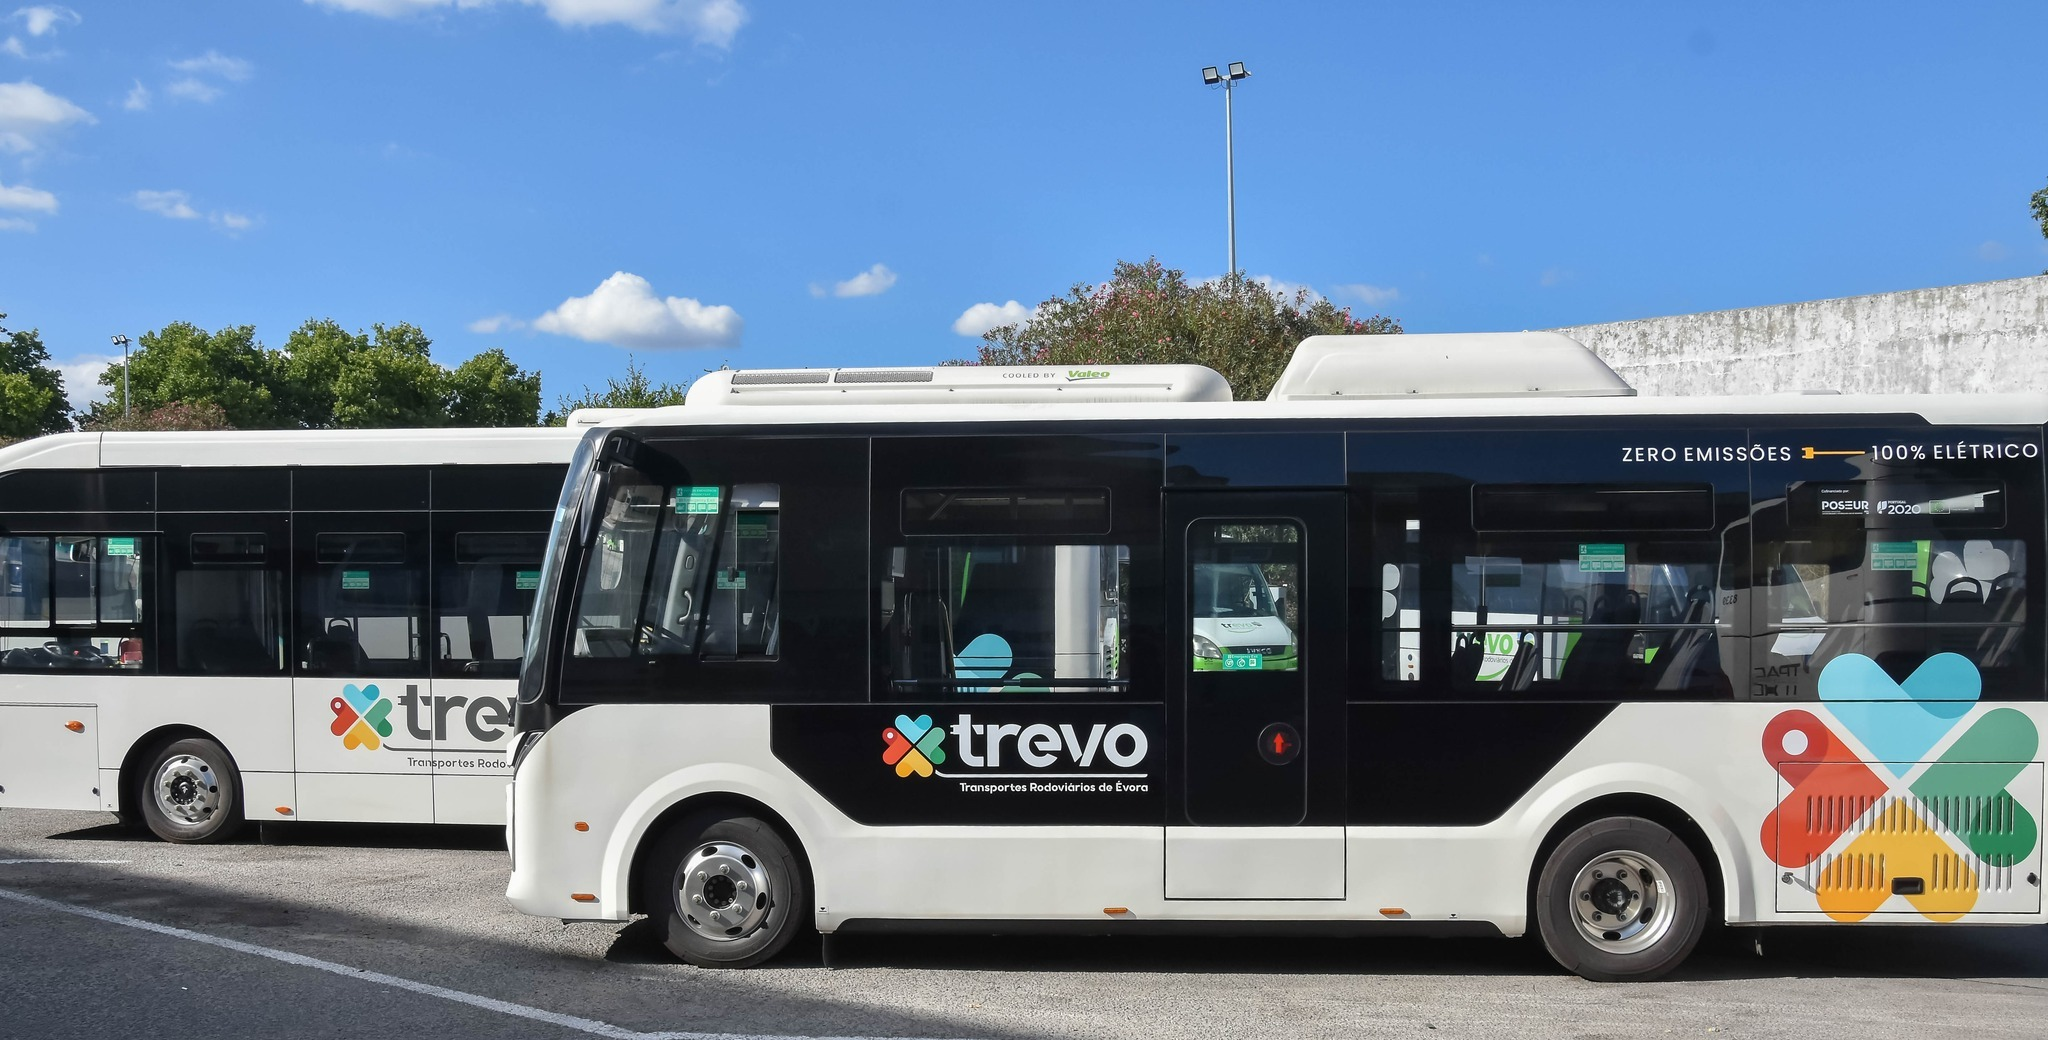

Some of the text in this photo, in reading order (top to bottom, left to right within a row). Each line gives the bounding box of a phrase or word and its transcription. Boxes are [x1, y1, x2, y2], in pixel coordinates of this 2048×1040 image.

[1068, 370, 1111, 378] Valeo
[1621, 444, 1791, 462] ZERO EMISSÕES
[1872, 441, 2038, 461] 100% ELÉTRICO
[1821, 501, 1869, 510] POSEUR
[1887, 504, 1922, 514] 2020
[398, 685, 516, 742] tre
[950, 714, 1148, 767] trevo
[407, 757, 475, 769] Transportes
[960, 780, 1149, 794] Transportes Rodoviários de Évora
